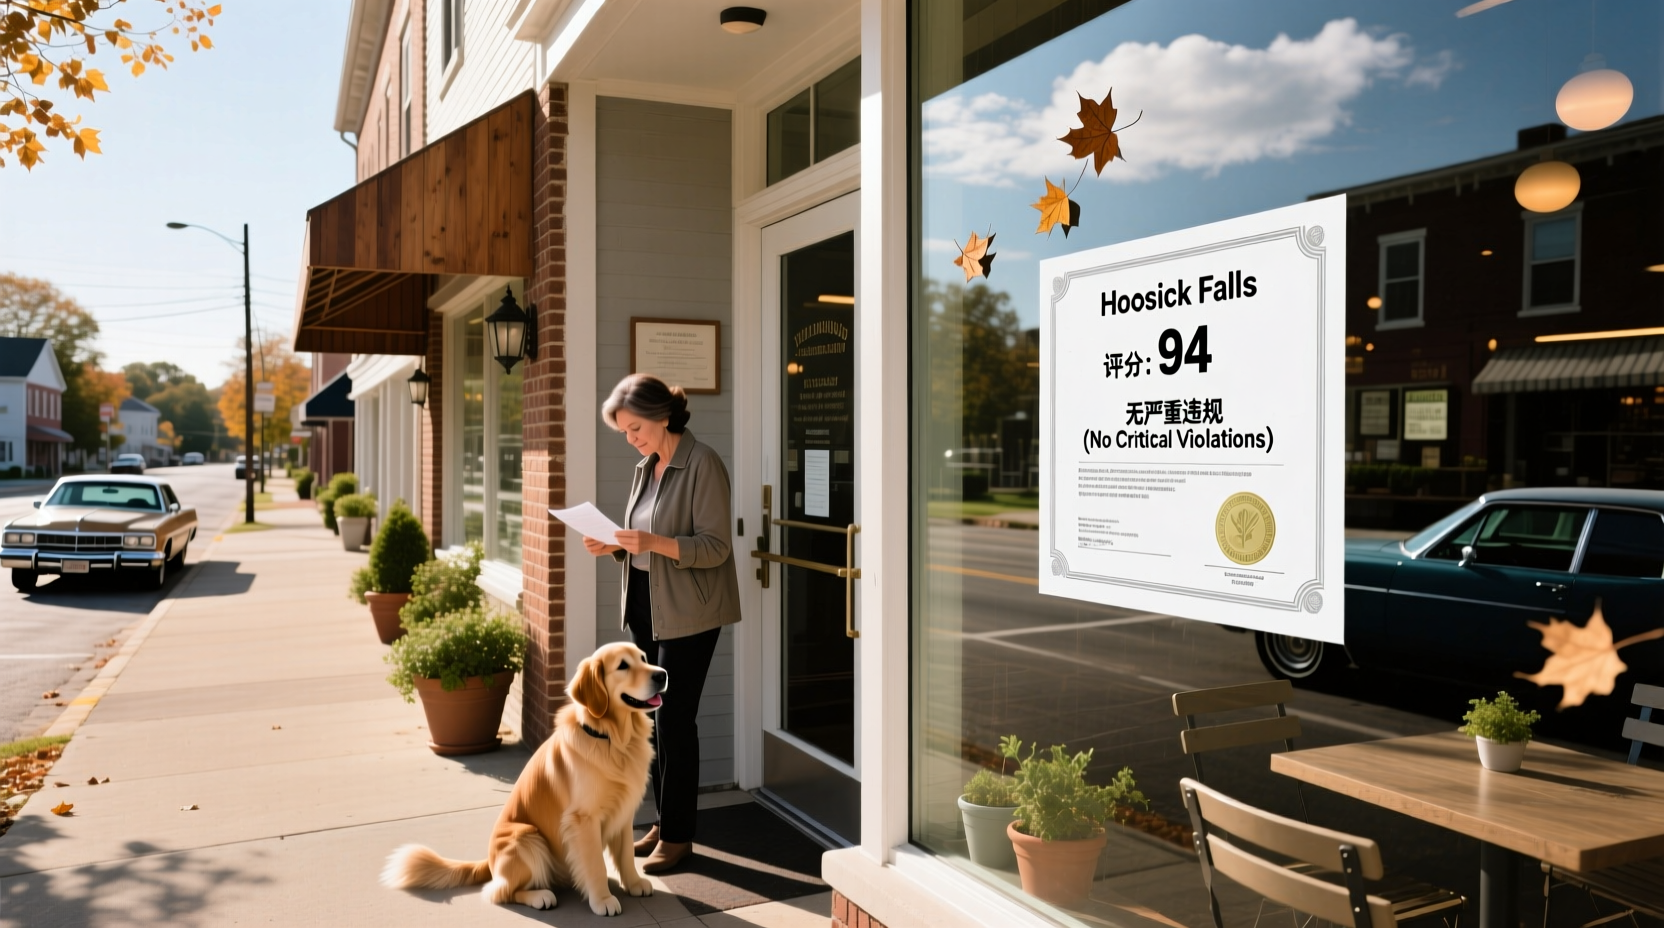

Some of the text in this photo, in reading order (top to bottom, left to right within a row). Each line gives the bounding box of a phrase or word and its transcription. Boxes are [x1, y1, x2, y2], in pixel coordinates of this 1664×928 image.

[1101, 269, 1258, 317] Hoosick Falls
[1103, 324, 1213, 380] 评分: 94
[1125, 397, 1224, 426] 无严重违规
[1083, 426, 1274, 455] (No Critical Violations)
